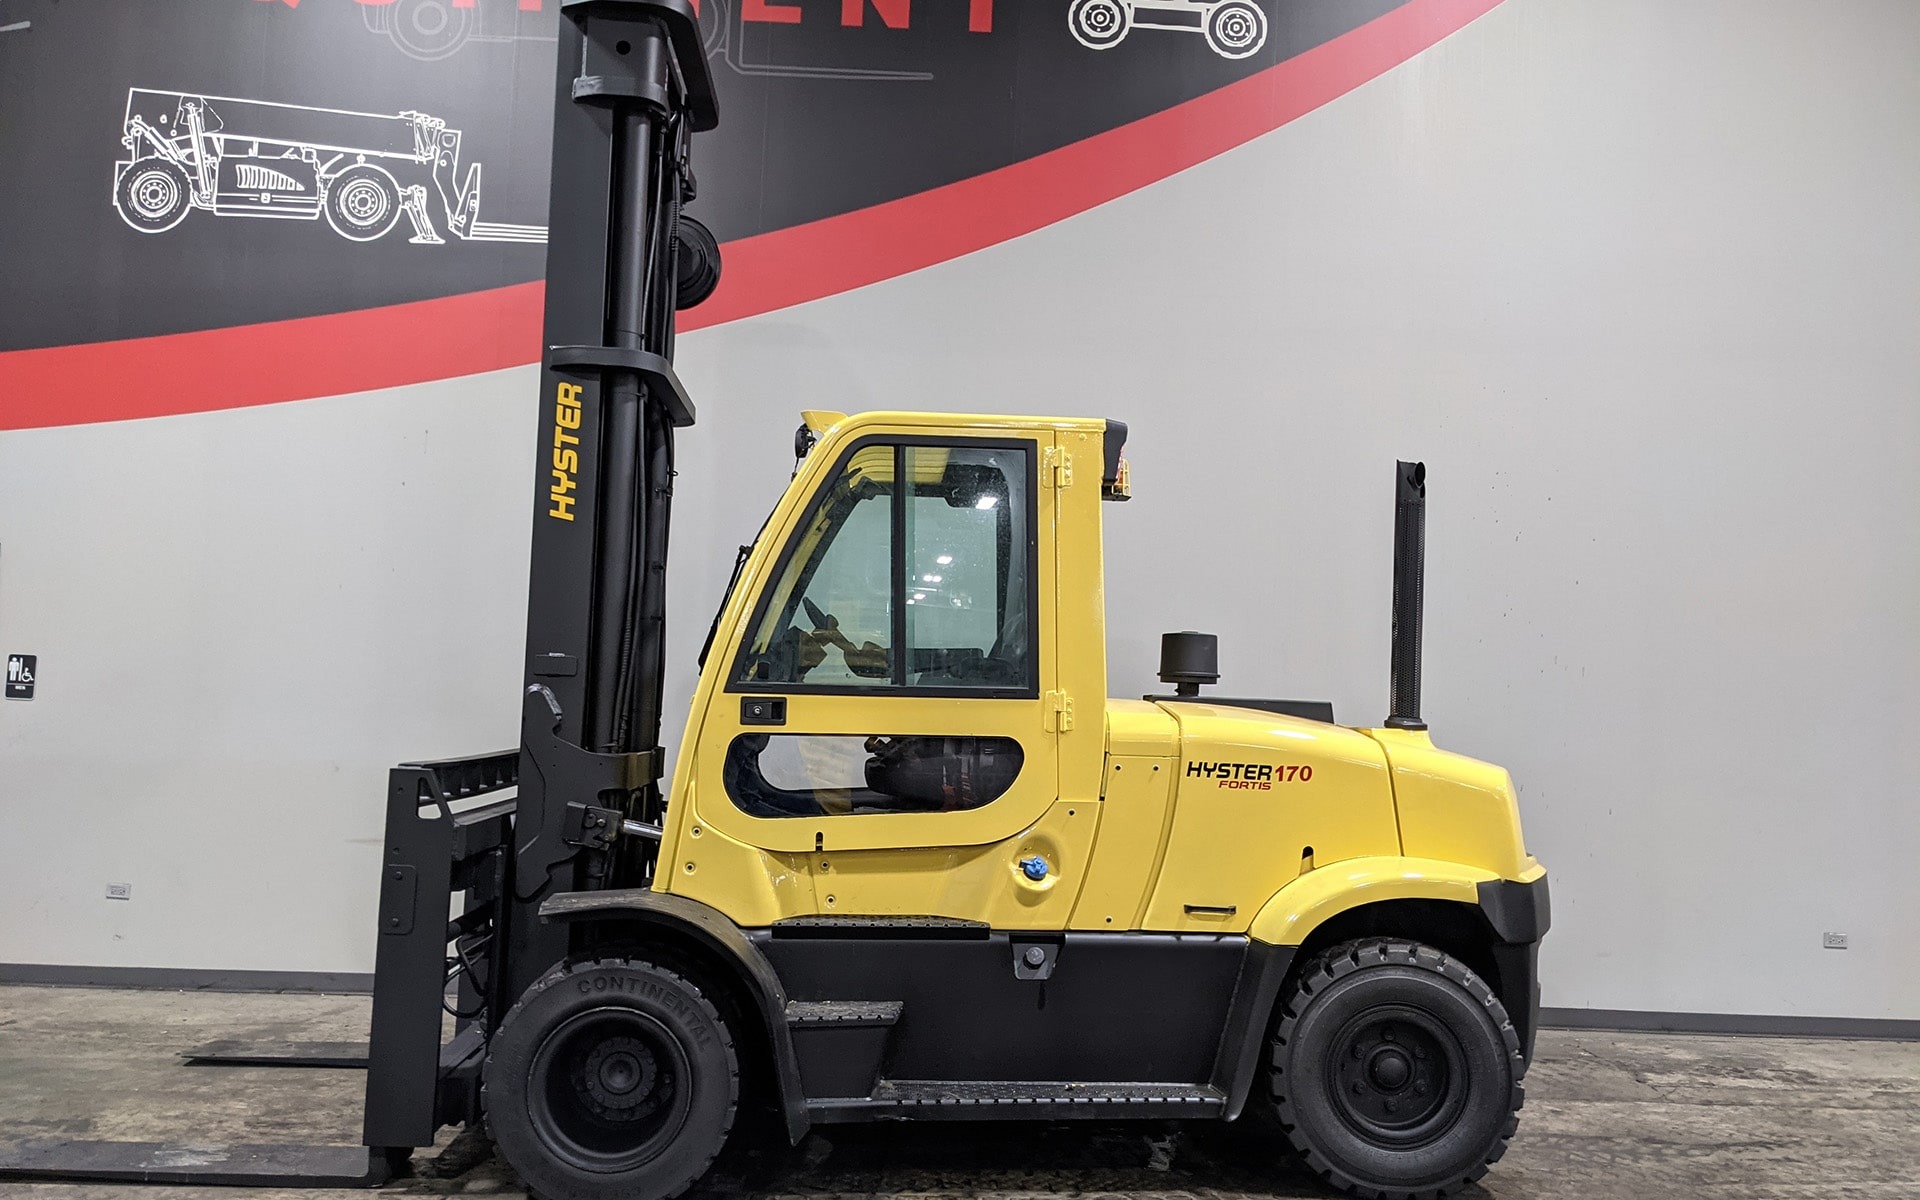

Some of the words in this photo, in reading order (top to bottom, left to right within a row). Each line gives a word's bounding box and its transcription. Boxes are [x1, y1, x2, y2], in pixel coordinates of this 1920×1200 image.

[549, 382, 583, 521] HYSTER
[1186, 761, 1273, 781] HYSTER
[1275, 765, 1313, 782] 170
[1218, 780, 1272, 791] FORTIS
[577, 975, 711, 1051] CONTINENTAL
